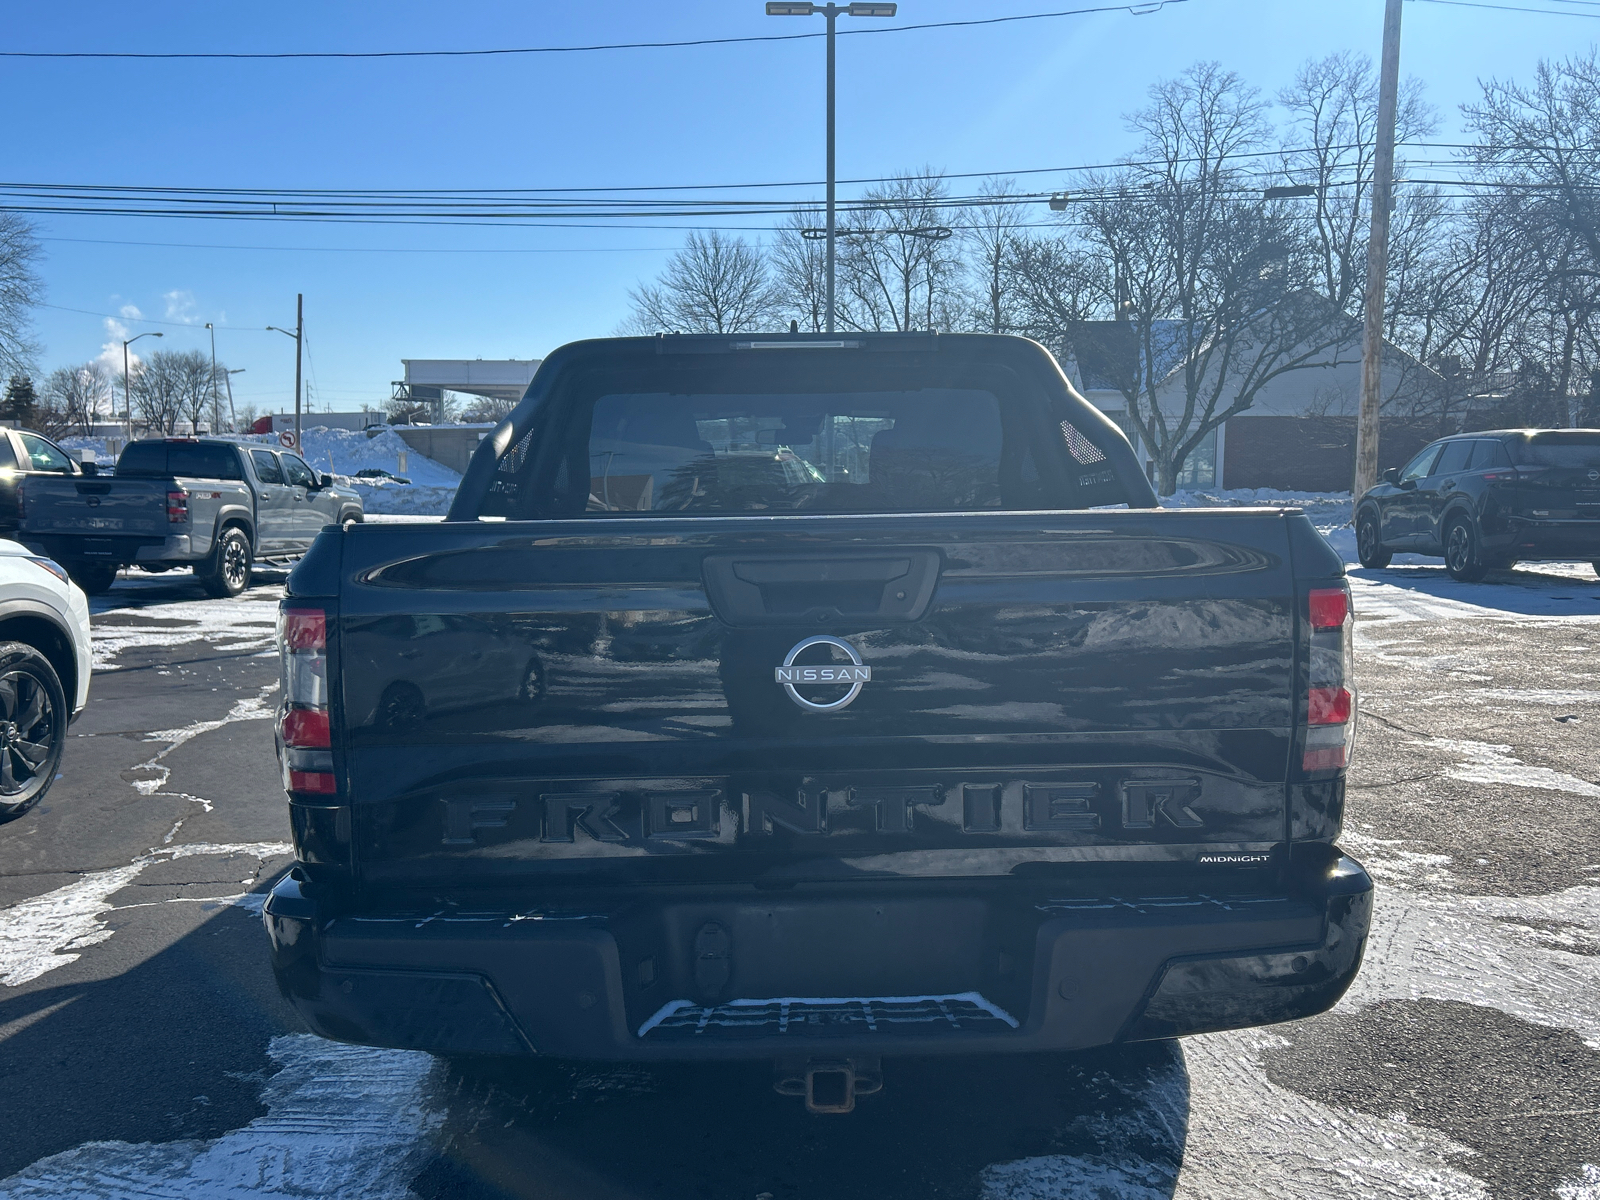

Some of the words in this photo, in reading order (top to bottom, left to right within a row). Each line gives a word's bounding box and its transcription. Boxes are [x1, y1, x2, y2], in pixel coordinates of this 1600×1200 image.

[777, 668, 869, 681] NISSAN
[441, 779, 1204, 844] FRONTIER
[1200, 855, 1270, 863] MIDNIGHT
